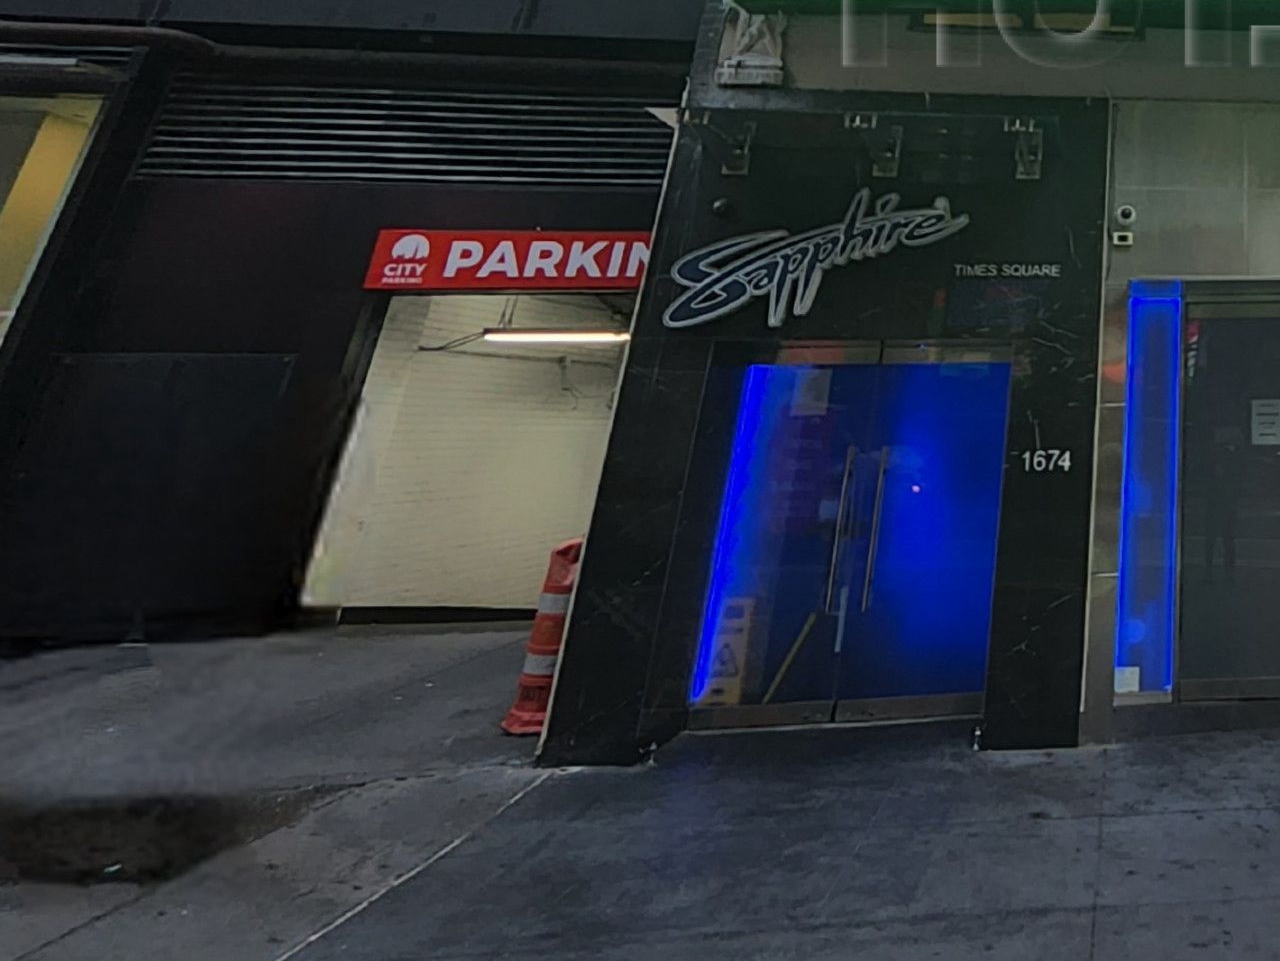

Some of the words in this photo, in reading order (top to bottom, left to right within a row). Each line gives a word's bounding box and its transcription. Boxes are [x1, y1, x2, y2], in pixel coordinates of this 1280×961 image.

[662, 187, 970, 327] Sapphire
[383, 263, 427, 276] CITY
[954, 263, 998, 277] TIMES
[1001, 263, 1062, 277] SQUARE
[1021, 449, 1072, 473] 1674
